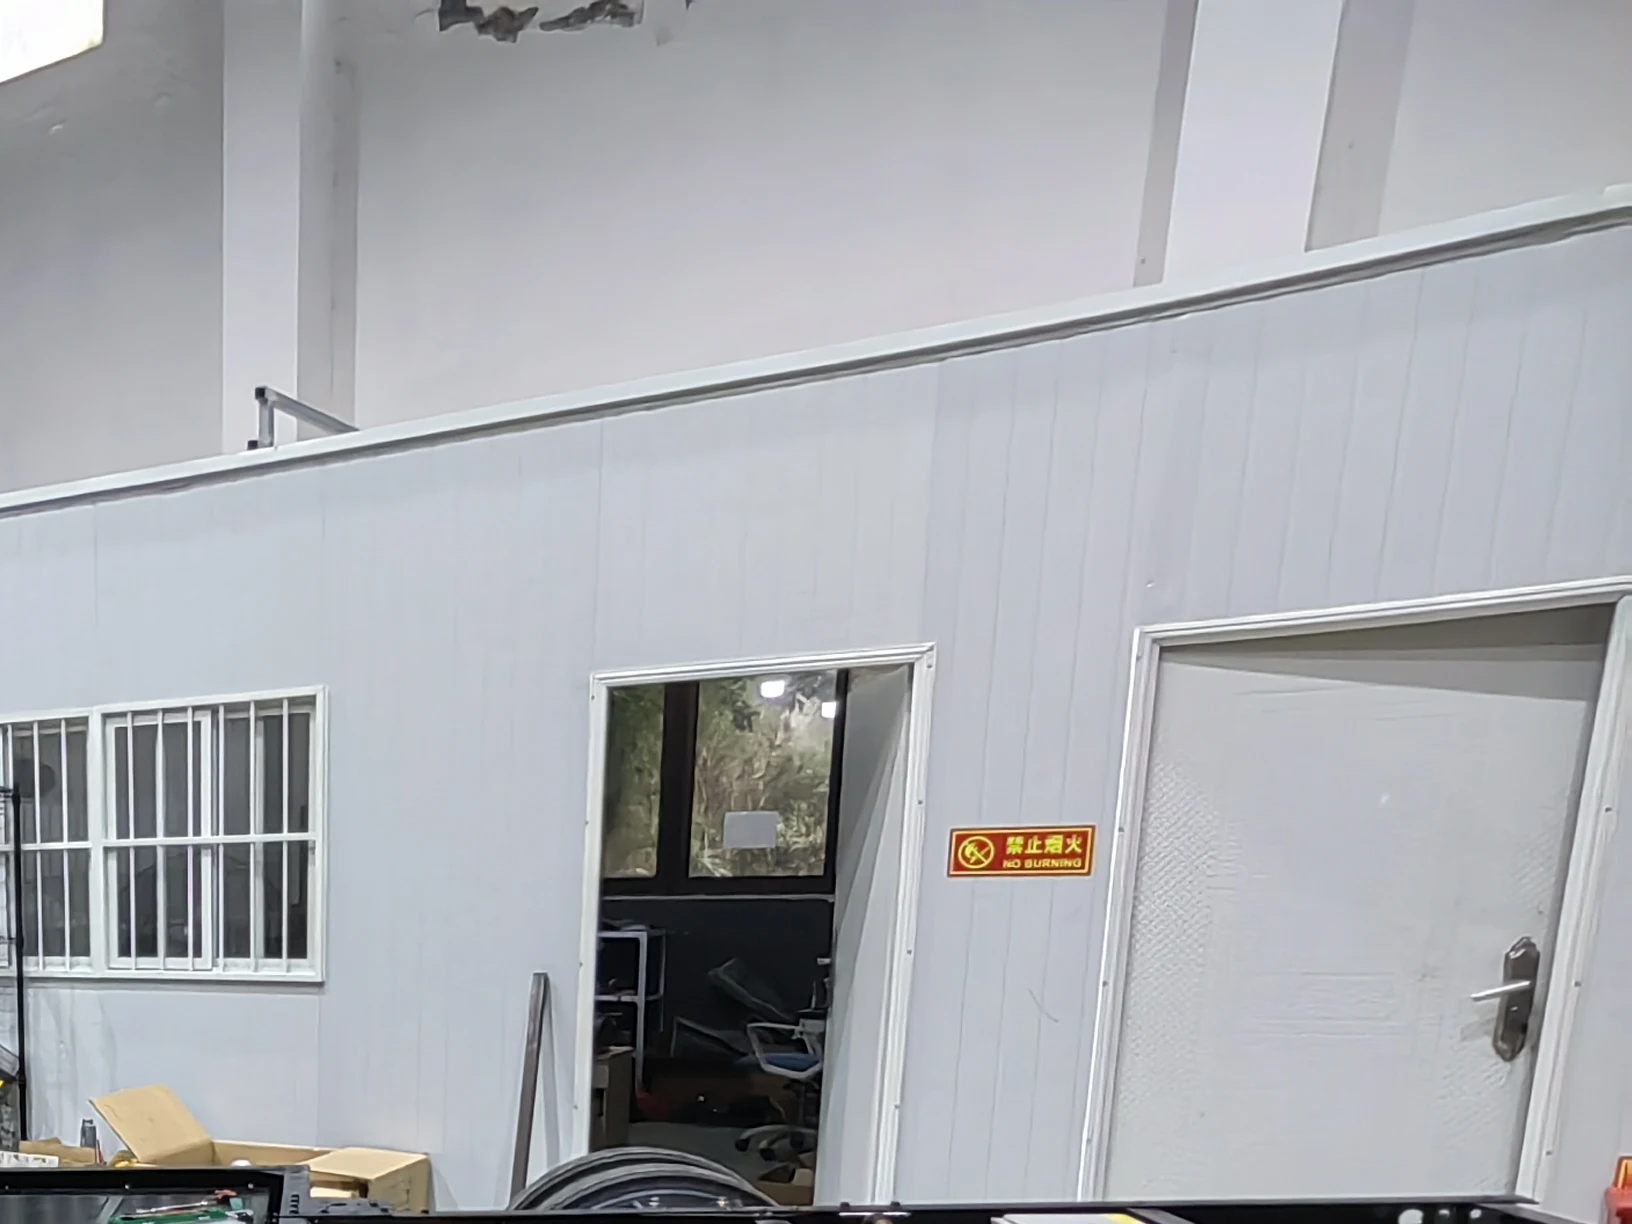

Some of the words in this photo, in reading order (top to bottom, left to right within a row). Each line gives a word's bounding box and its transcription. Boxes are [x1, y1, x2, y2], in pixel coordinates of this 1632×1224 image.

[1006, 834, 1082, 854] 禁止烟火
[1003, 859, 1021, 869] NO
[1024, 858, 1082, 868] BURNING
